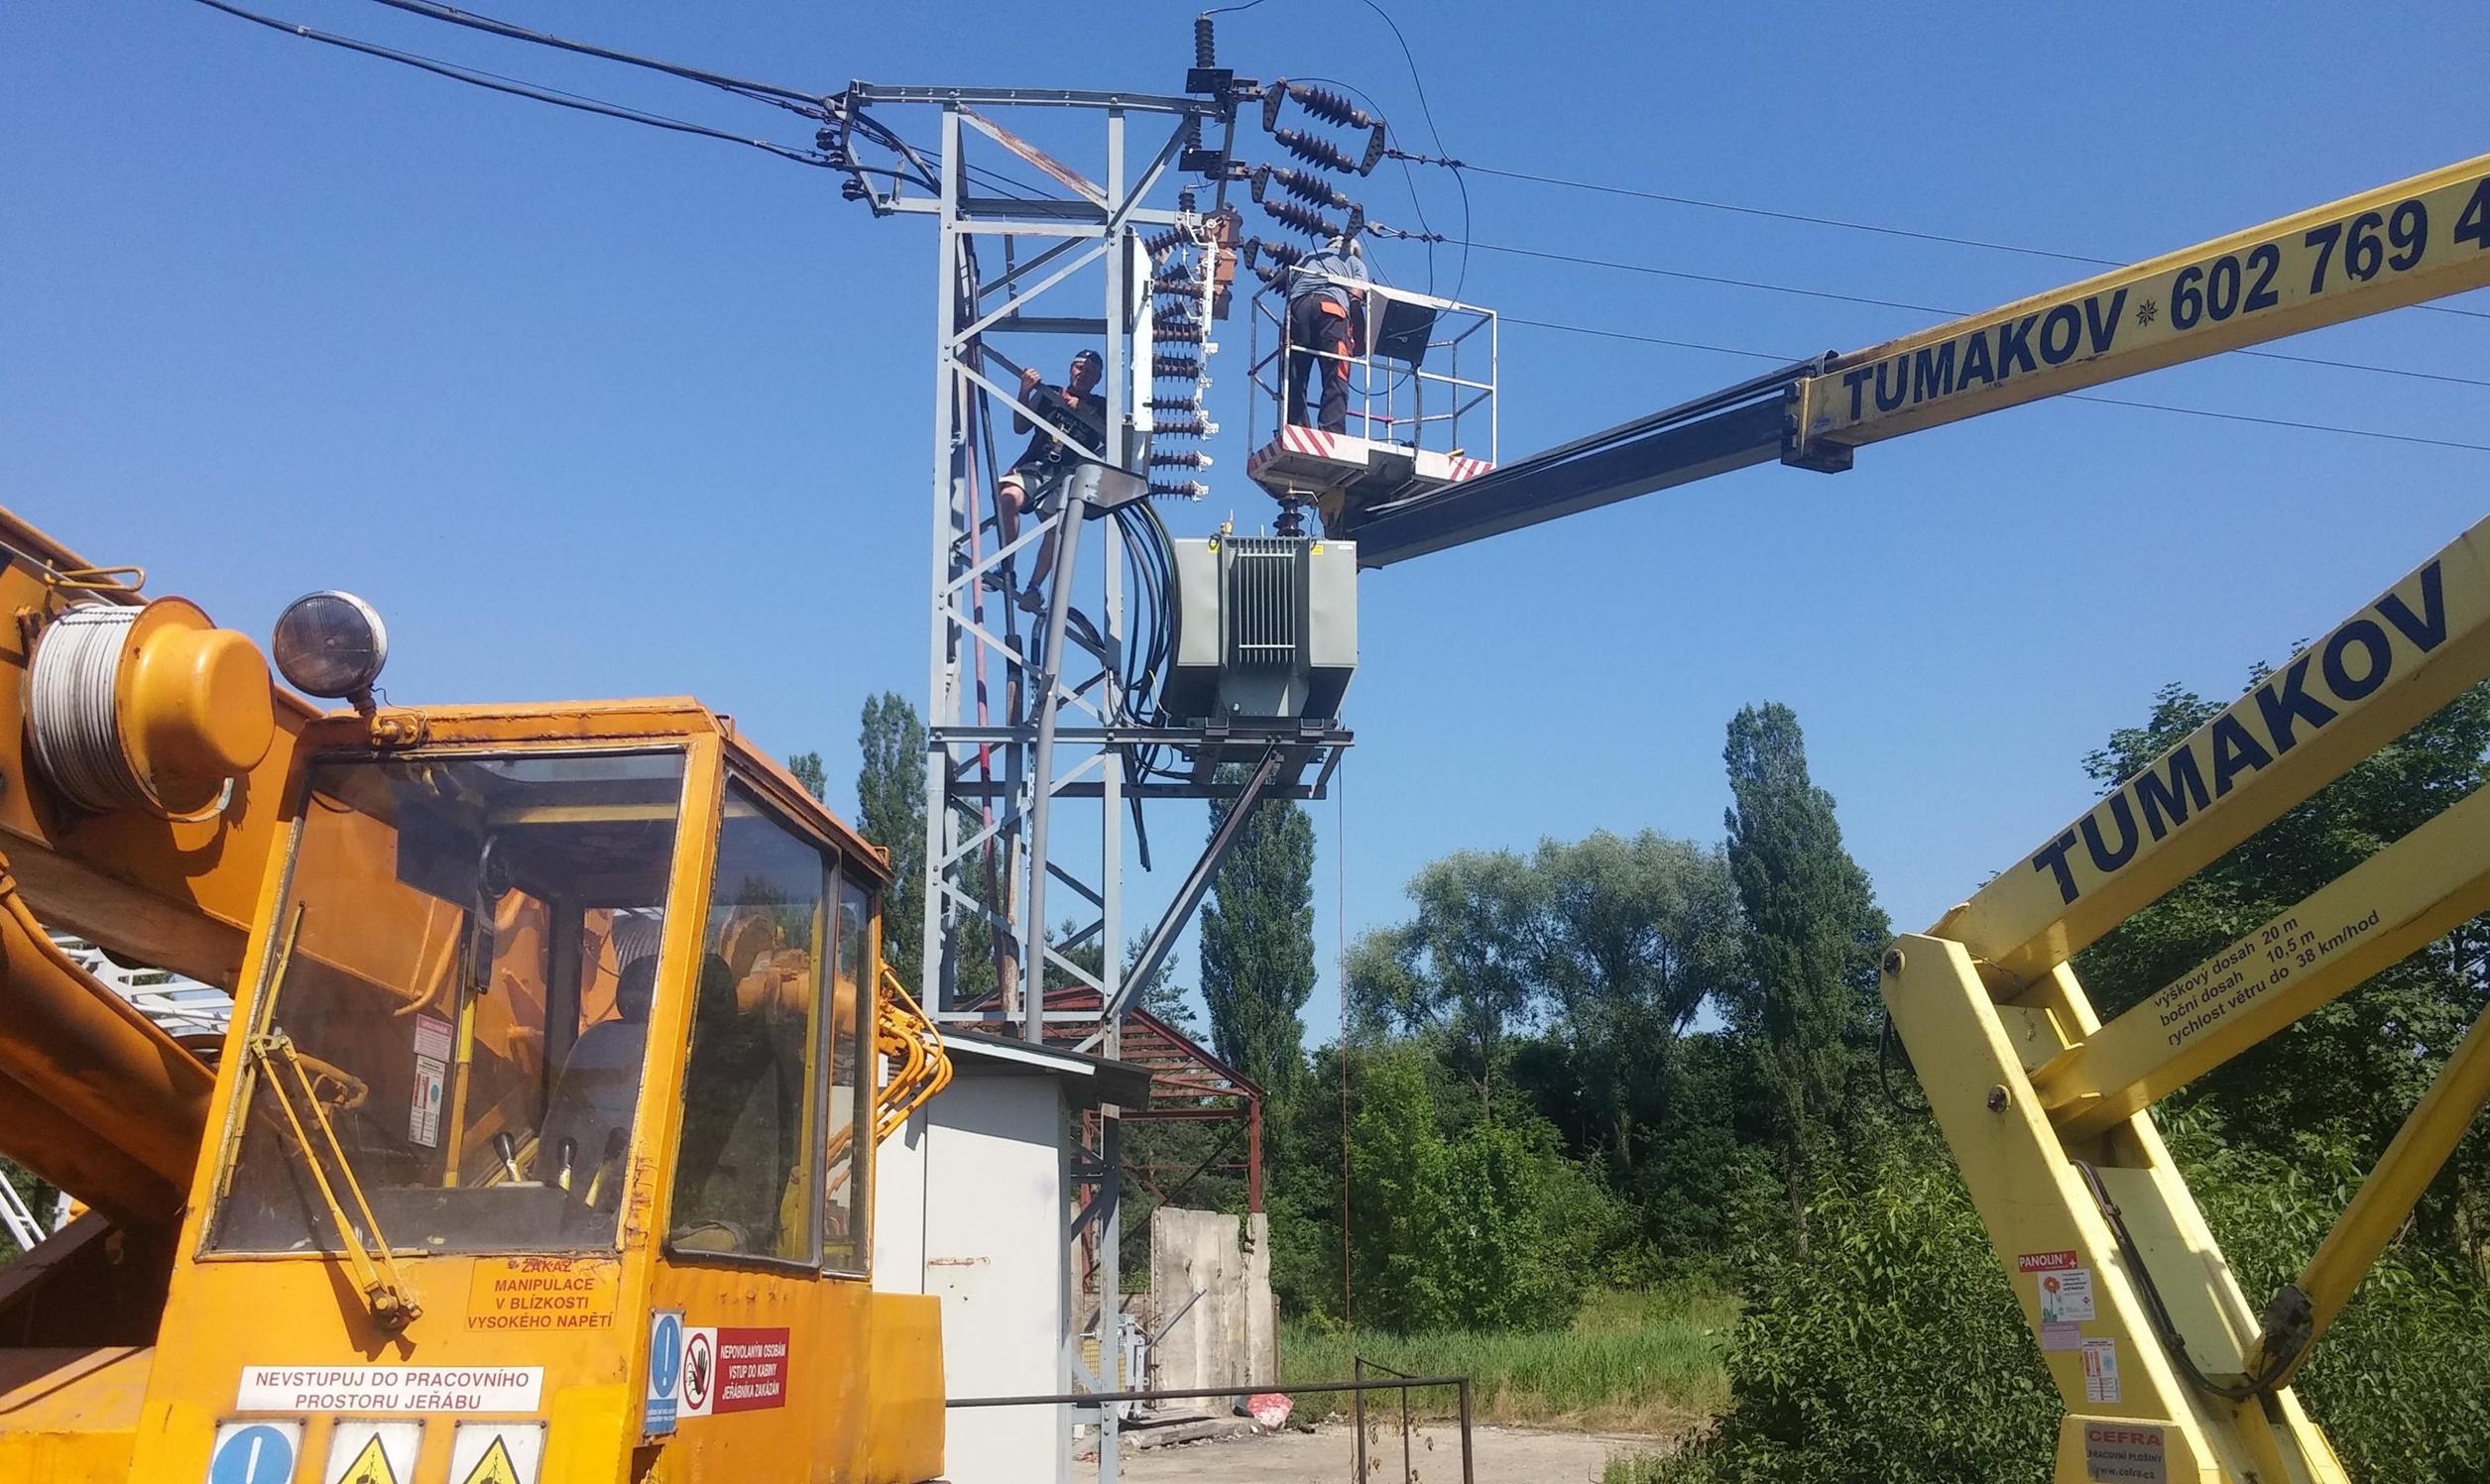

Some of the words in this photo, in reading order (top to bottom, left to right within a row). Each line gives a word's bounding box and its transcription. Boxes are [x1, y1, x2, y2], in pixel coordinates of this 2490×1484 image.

[1842, 288, 2129, 421] TUMAKOV
[2170, 243, 2280, 331] 602
[2304, 198, 2429, 295] 769
[2453, 176, 2490, 250] 4
[2032, 560, 2447, 905] TUMAKOV
[2153, 968, 2209, 1010] výškový
[2211, 943, 2256, 976] dosah
[2260, 926, 2280, 946] 20
[2283, 917, 2299, 934] m
[2200, 970, 2244, 1004] dosah
[2265, 938, 2297, 966] 10,5
[2300, 930, 2315, 948] m
[2167, 1004, 2227, 1047] rychlost
[2227, 980, 2267, 1009] větru
[2269, 965, 2290, 985] do
[2296, 949, 2316, 969] 38
[2318, 909, 2380, 956] km/hod
[2019, 1253, 2063, 1268] PANOLIN
[494, 1278, 596, 1293] MANIPULACE
[496, 1298, 506, 1310] V
[510, 1294, 589, 1310] BLÍZKOSTI
[467, 1313, 551, 1328] VYSOKÉHO
[556, 1312, 614, 1328] NAPĚTÍ
[255, 1371, 365, 1387] NEVSTUPUJ
[371, 1372, 399, 1387] DO
[405, 1369, 530, 1388] PRACOVNÍHO
[729, 1364, 747, 1379] VSTUP
[748, 1363, 757, 1378] DO
[757, 1362, 777, 1378] KABINY
[295, 1394, 399, 1409] PROSTORU
[405, 1391, 482, 1410] JEŘÁBU
[2088, 1429, 2162, 1445] CEFRA
